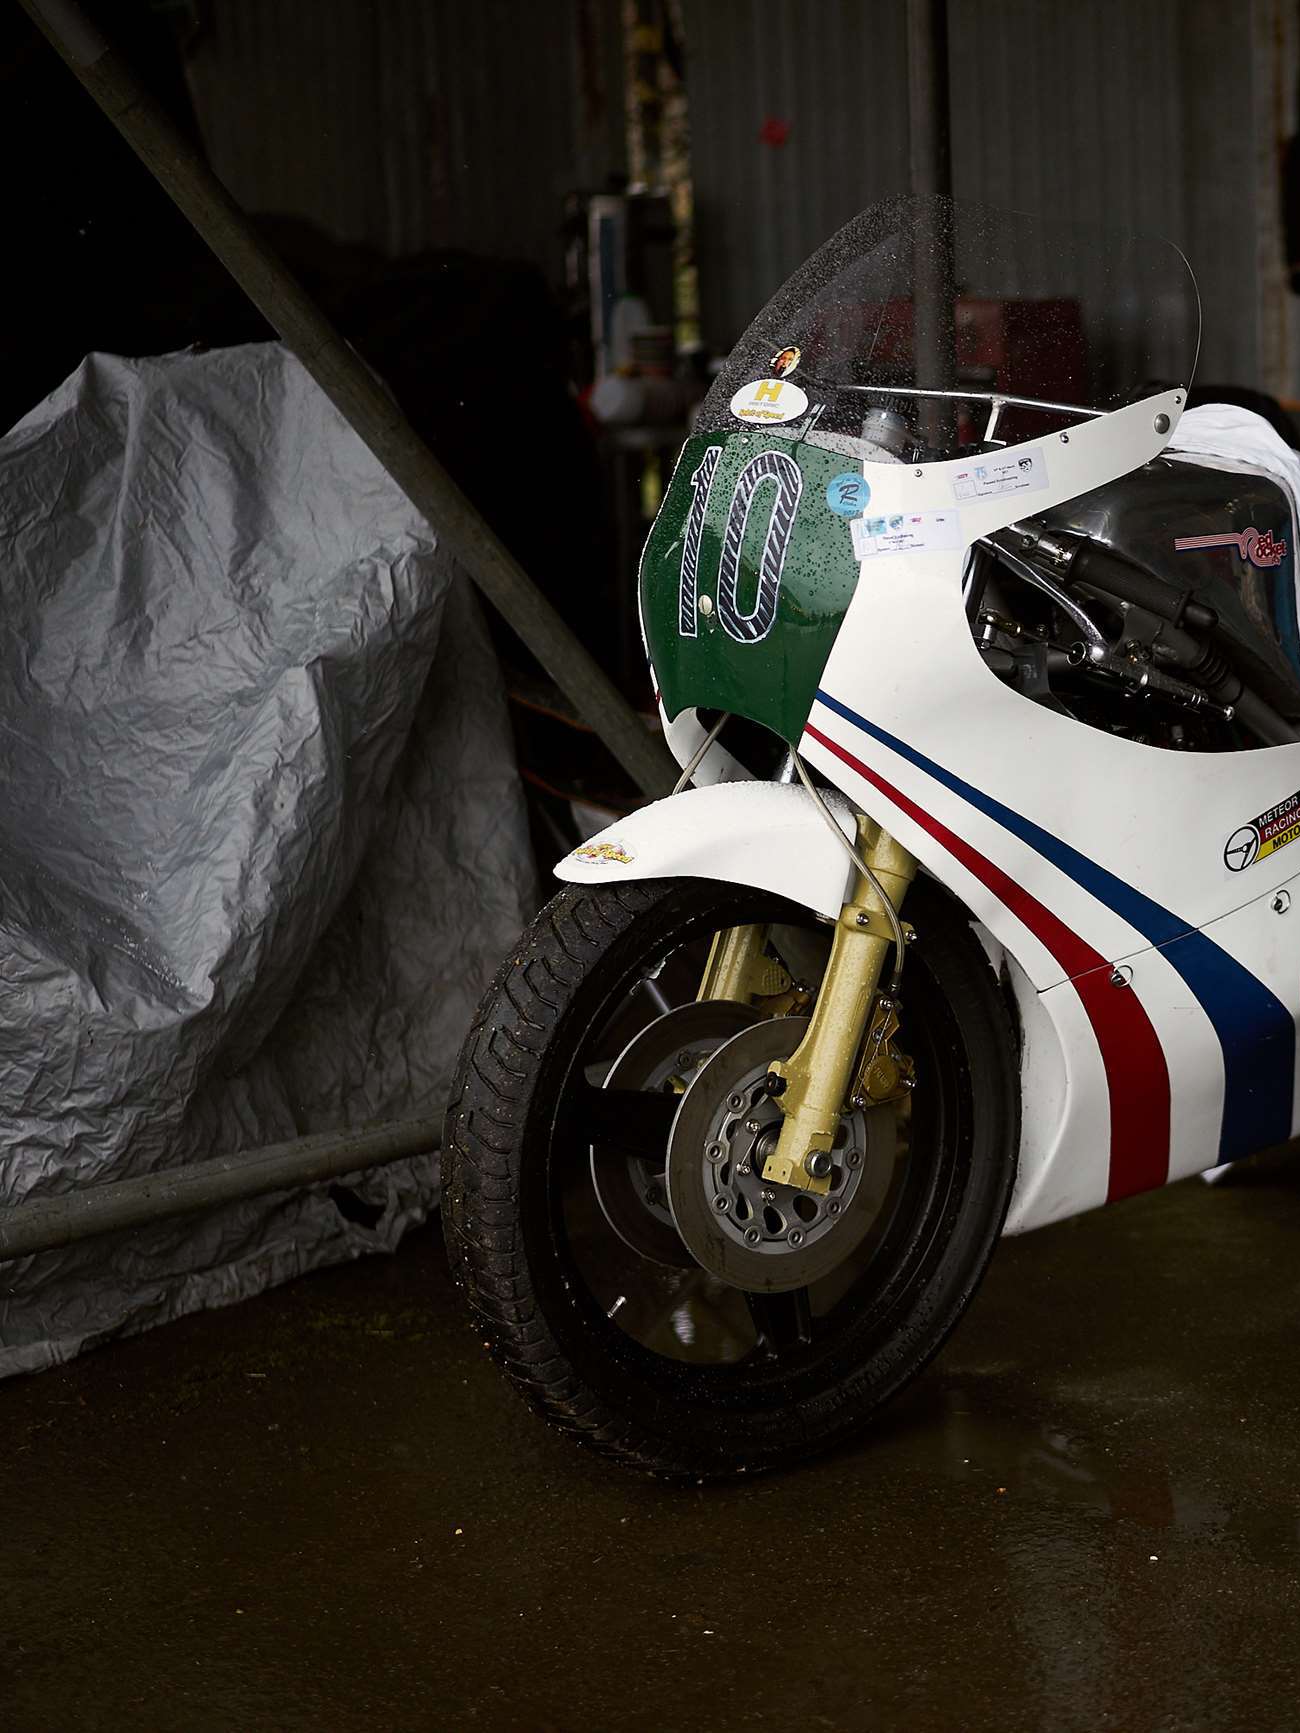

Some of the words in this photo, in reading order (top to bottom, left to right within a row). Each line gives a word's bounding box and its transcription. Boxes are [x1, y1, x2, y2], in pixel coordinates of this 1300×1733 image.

[754, 380, 784, 402] H
[839, 483, 860, 505] R
[678, 445, 803, 644] 10
[1258, 796, 1299, 828] METEOR
